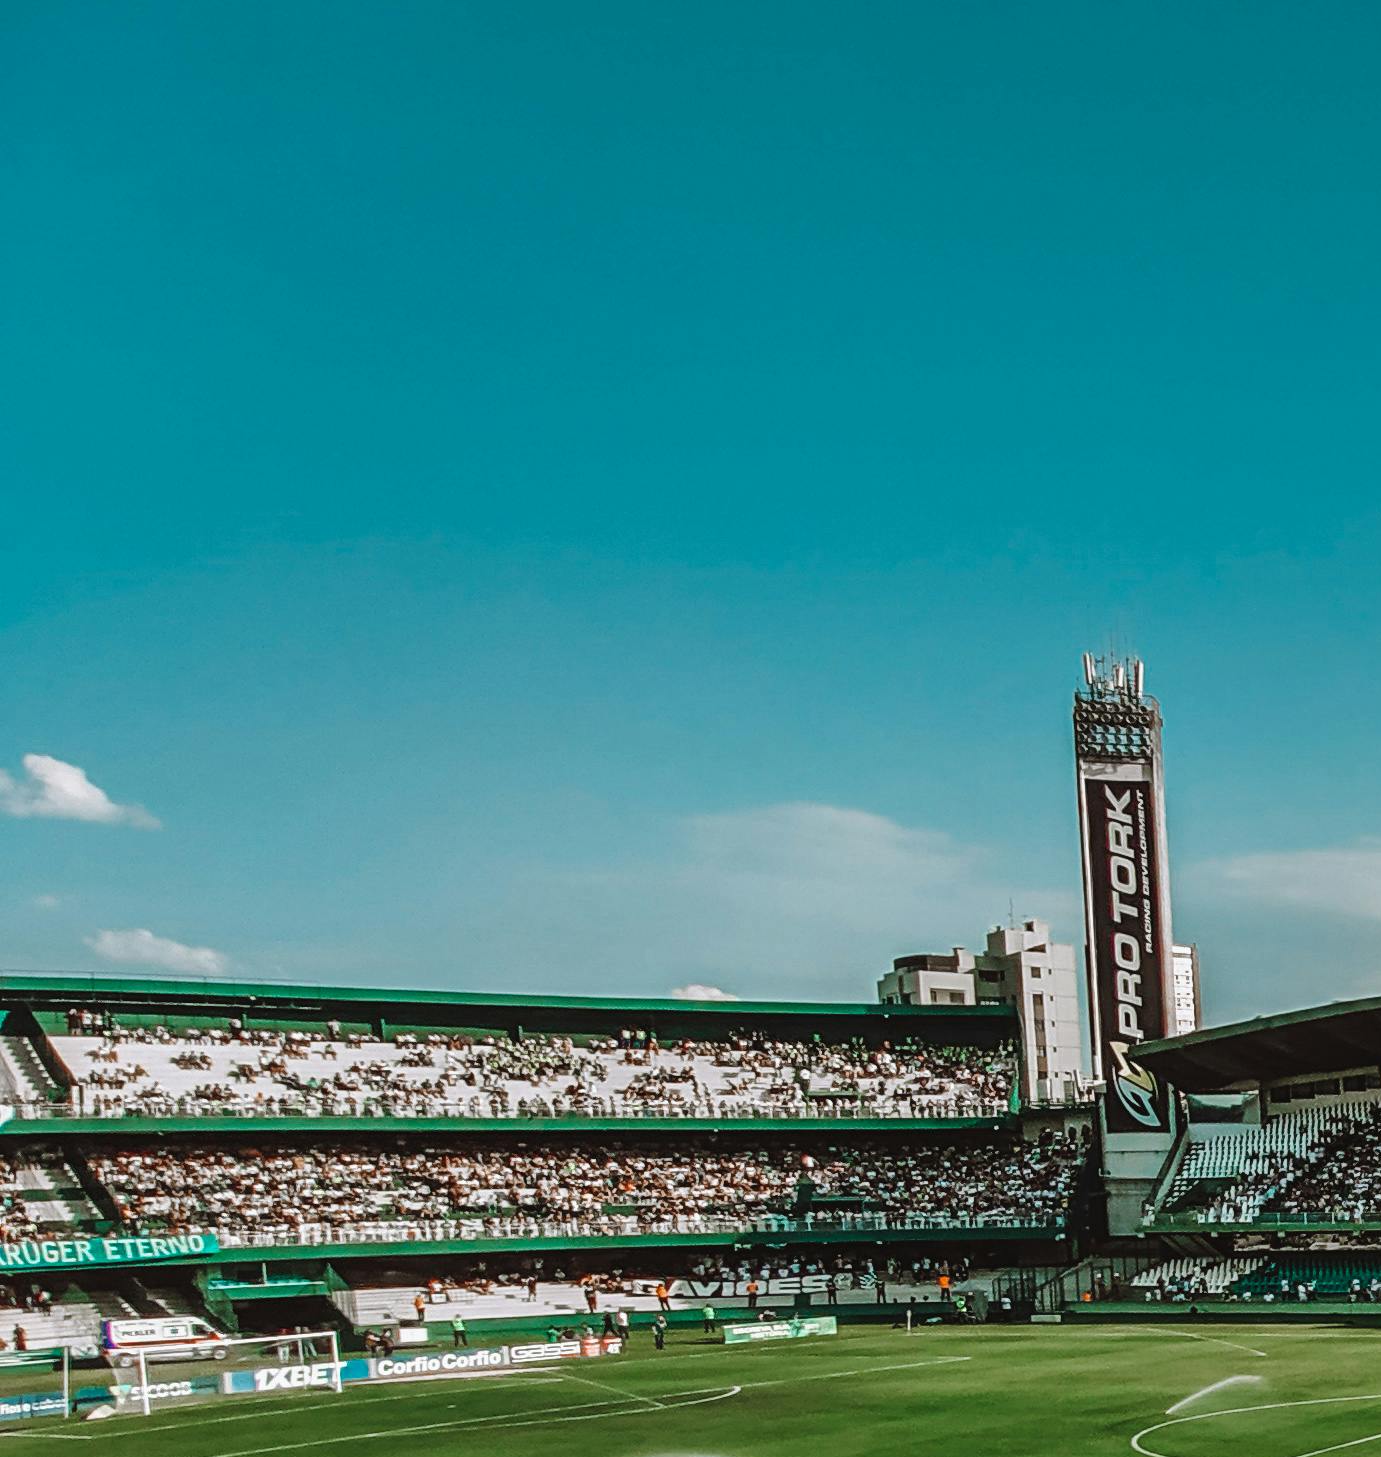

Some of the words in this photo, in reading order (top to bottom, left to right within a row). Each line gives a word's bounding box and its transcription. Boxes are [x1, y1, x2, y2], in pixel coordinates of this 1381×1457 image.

[1104, 784, 1139, 924] TORK
[1135, 789, 1151, 897] DEVELOPMENT
[1142, 899, 1153, 954] RACING
[1113, 932, 1145, 1042] PRO
[103, 1234, 205, 1259] ETERNO
[255, 1361, 347, 1391] 1XBET
[378, 1356, 441, 1376] Corfio
[442, 1349, 500, 1369] Corfio
